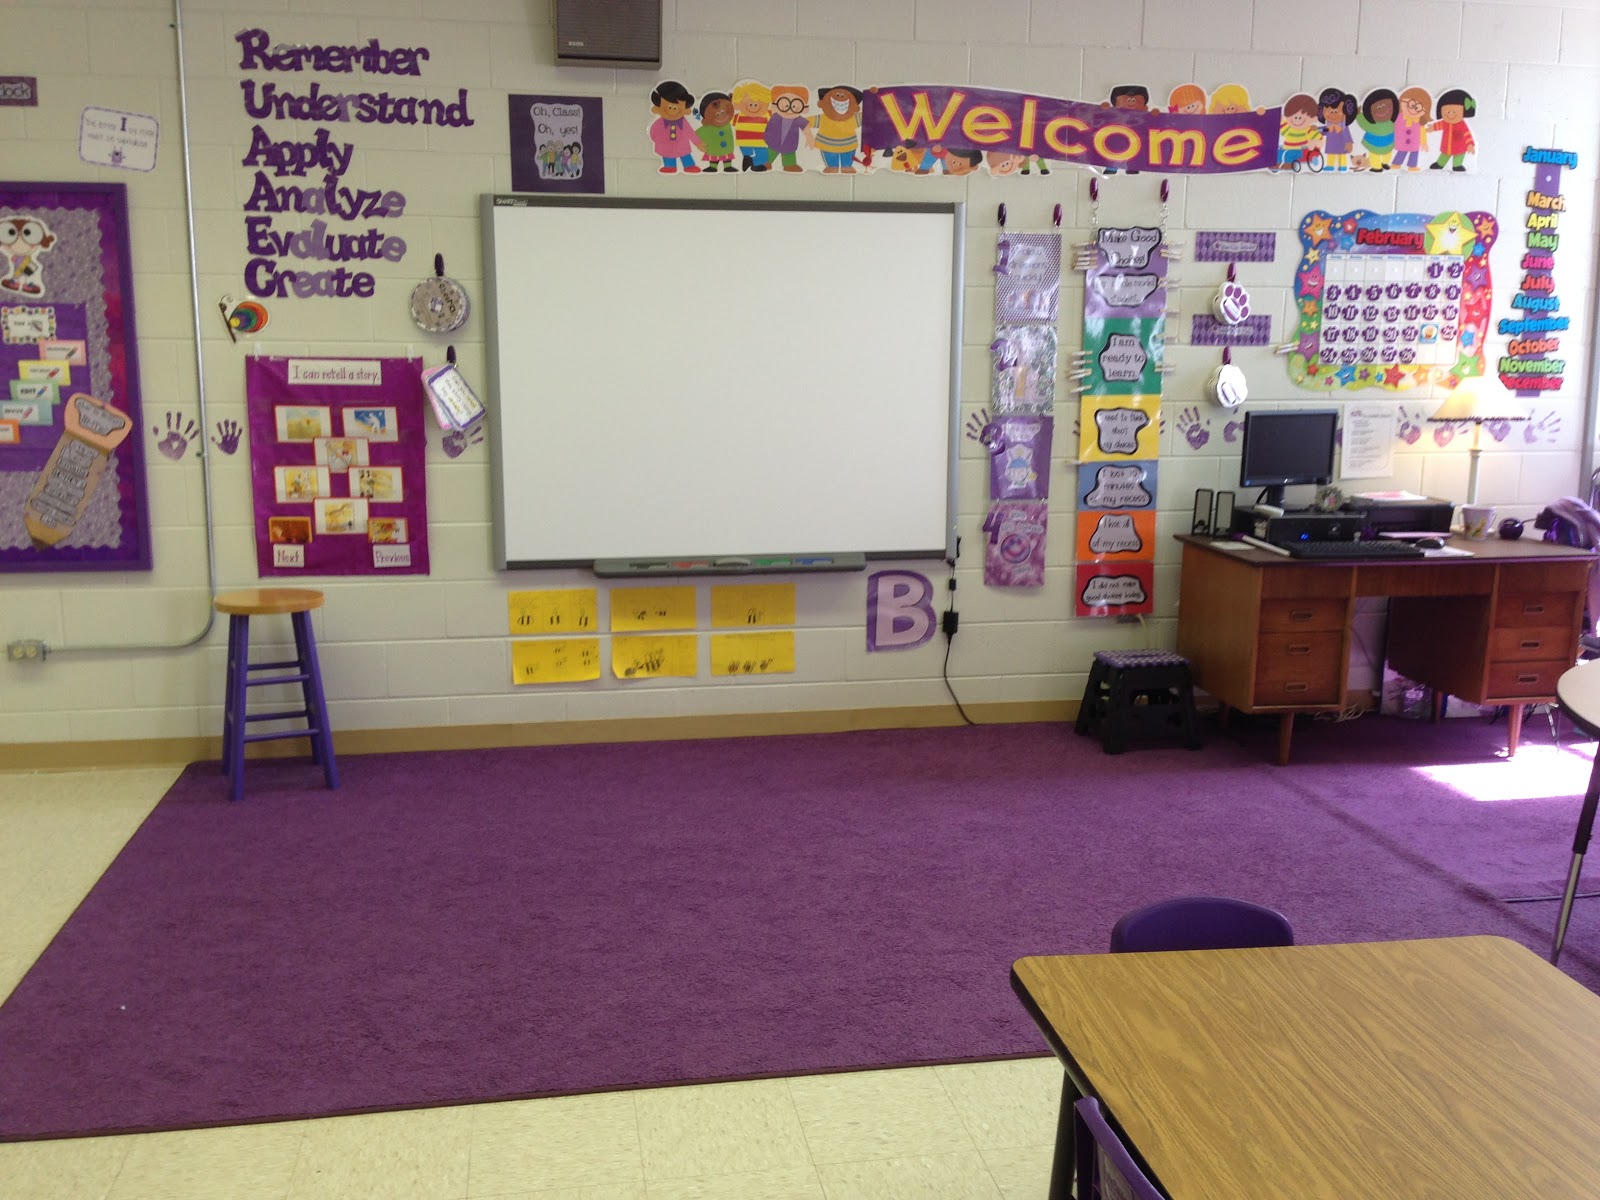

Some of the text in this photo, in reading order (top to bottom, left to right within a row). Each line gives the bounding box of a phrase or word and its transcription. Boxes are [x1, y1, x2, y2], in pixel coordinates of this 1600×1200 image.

[235, 27, 430, 76] Remember
[241, 79, 474, 127] Understand
[533, 105, 581, 117] Oh, Class!
[537, 123, 578, 137] Oh, yes!
[879, 91, 1263, 167] Welcome
[242, 125, 354, 176] Apply
[1522, 146, 1578, 169] January
[244, 172, 406, 220] Analyze
[1526, 190, 1567, 212] March
[1527, 212, 1558, 229] April
[246, 217, 407, 261] Evaluate
[1131, 231, 1157, 243] Good
[1356, 228, 1425, 249] February
[1527, 231, 1559, 252] May
[1521, 253, 1555, 270] June
[244, 259, 375, 298] Create
[1521, 275, 1555, 294] July
[1511, 293, 1560, 312] August
[1327, 305, 1456, 321] 10 11 12 13 14 15 16
[1326, 327, 1338, 340] 17
[1345, 328, 1356, 340] 18
[1366, 327, 1377, 340] 19
[1385, 328, 1398, 340] 20
[1405, 327, 1418, 339] 21
[1498, 317, 1570, 335] September
[1508, 338, 1559, 356] October
[1102, 353, 1144, 363] ready to
[1499, 357, 1565, 375] November
[294, 365, 299, 379] I
[303, 369, 319, 379] can
[322, 367, 346, 379] retell
[348, 370, 354, 380] a
[1109, 368, 1137, 377] learn.
[1499, 375, 1563, 391] December
[277, 550, 299, 562] Next
[376, 551, 409, 562] Previous
[874, 573, 930, 648] B
